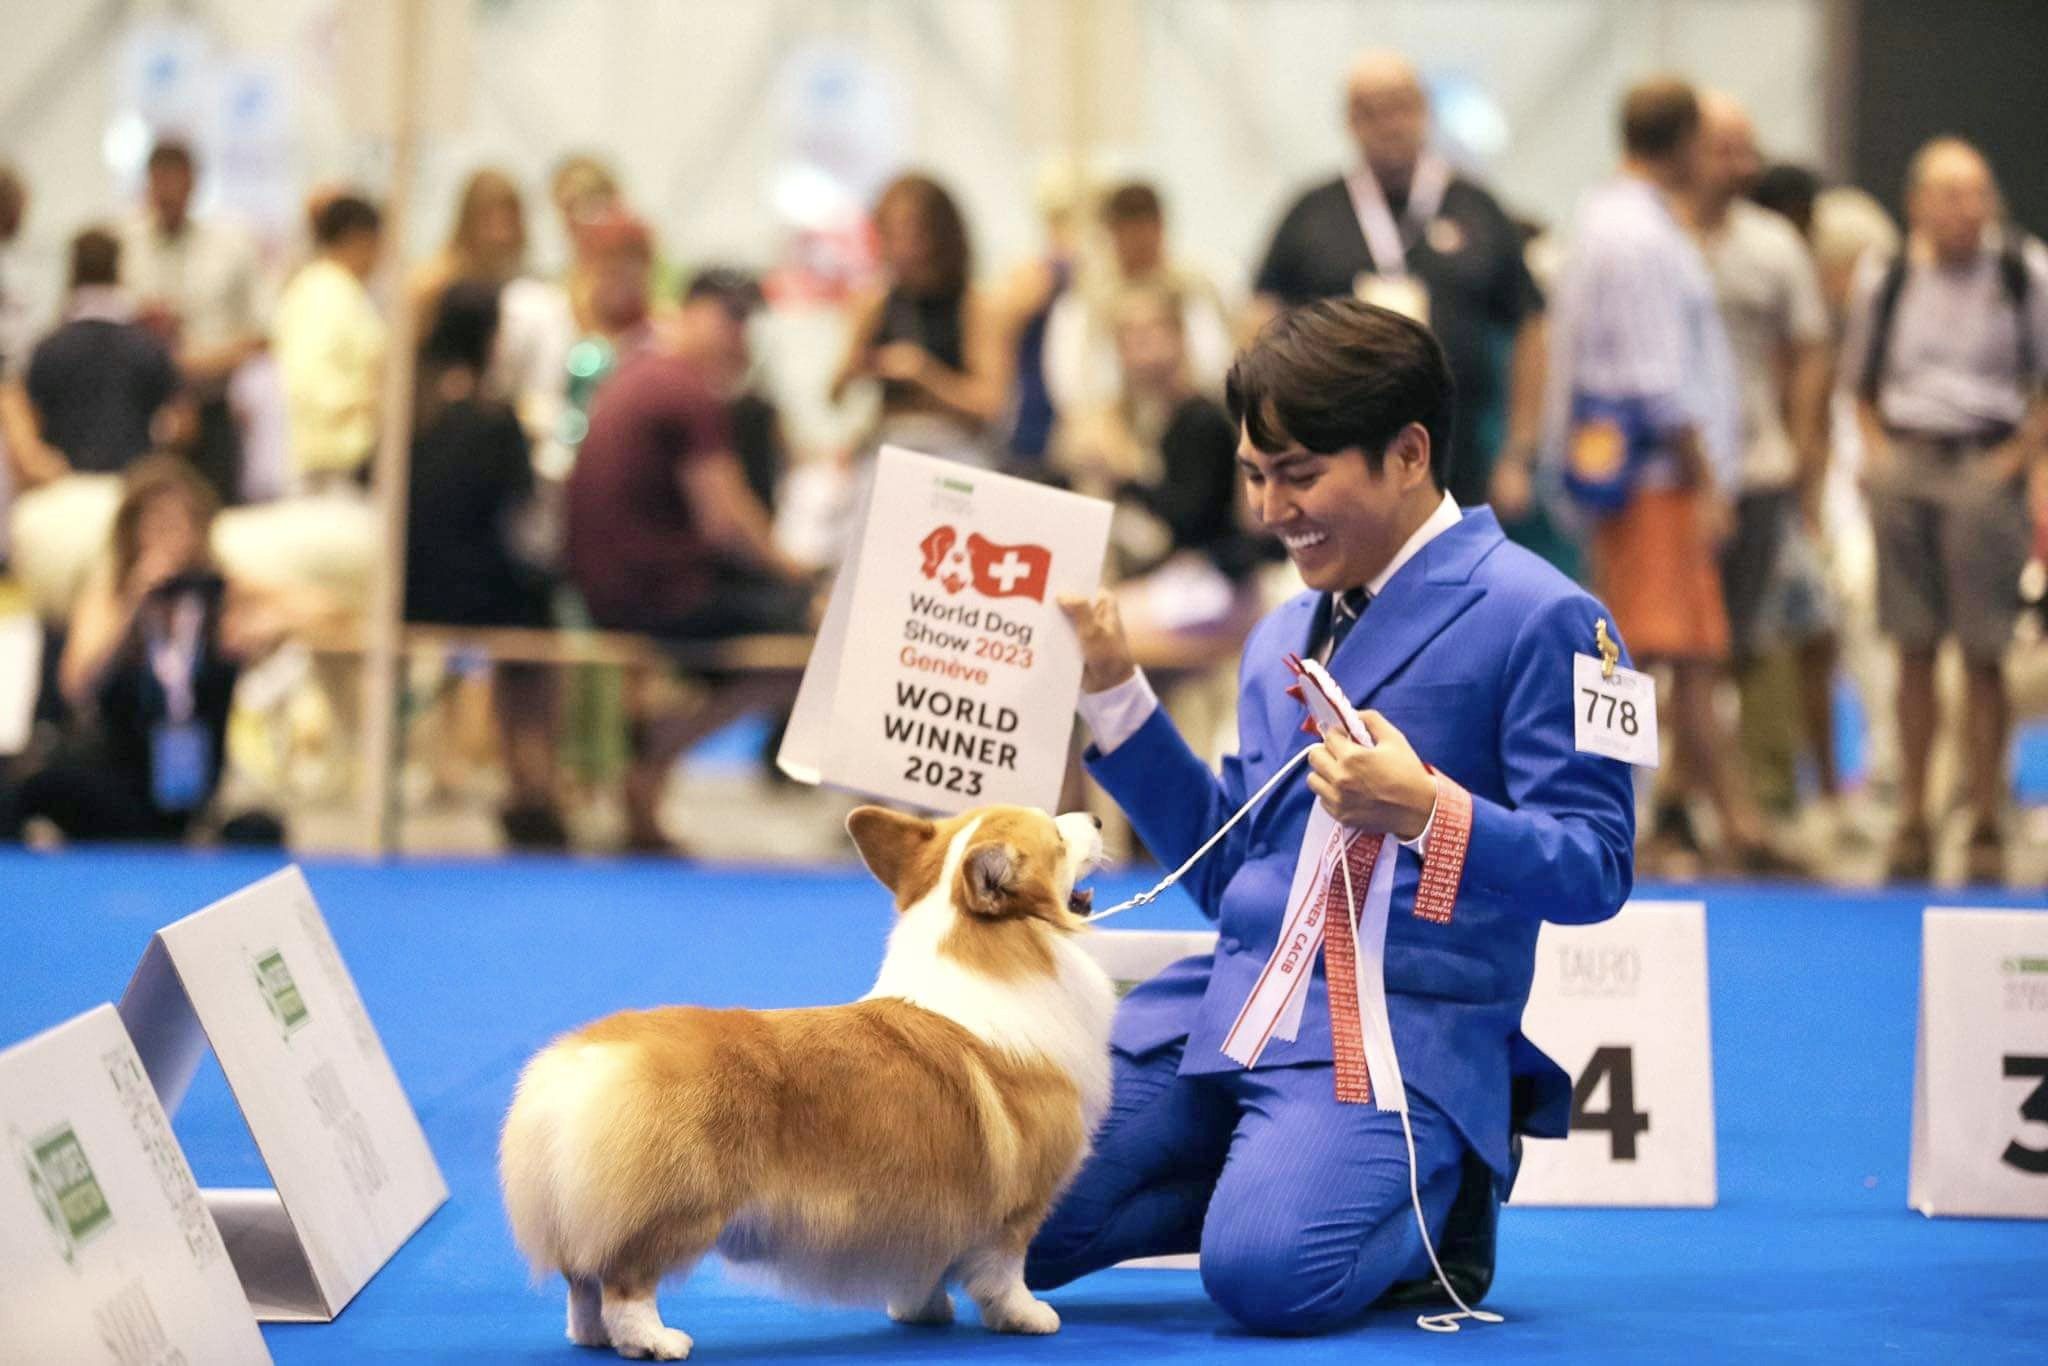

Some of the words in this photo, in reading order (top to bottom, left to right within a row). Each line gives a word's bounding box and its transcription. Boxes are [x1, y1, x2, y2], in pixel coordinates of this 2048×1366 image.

[909, 592, 979, 629] World
[985, 611, 1034, 646] Dog
[899, 647, 990, 685] Genève
[903, 620, 970, 653] Show
[975, 638, 1034, 669] 2023
[895, 681, 1019, 733] WORLD
[1581, 688, 1639, 736] 778
[884, 714, 1017, 770] WINNER
[903, 756, 985, 797] 2023
[1280, 932, 1308, 975] CACIB
[1568, 1046, 1650, 1162] 4
[2001, 1054, 2048, 1177] 3
